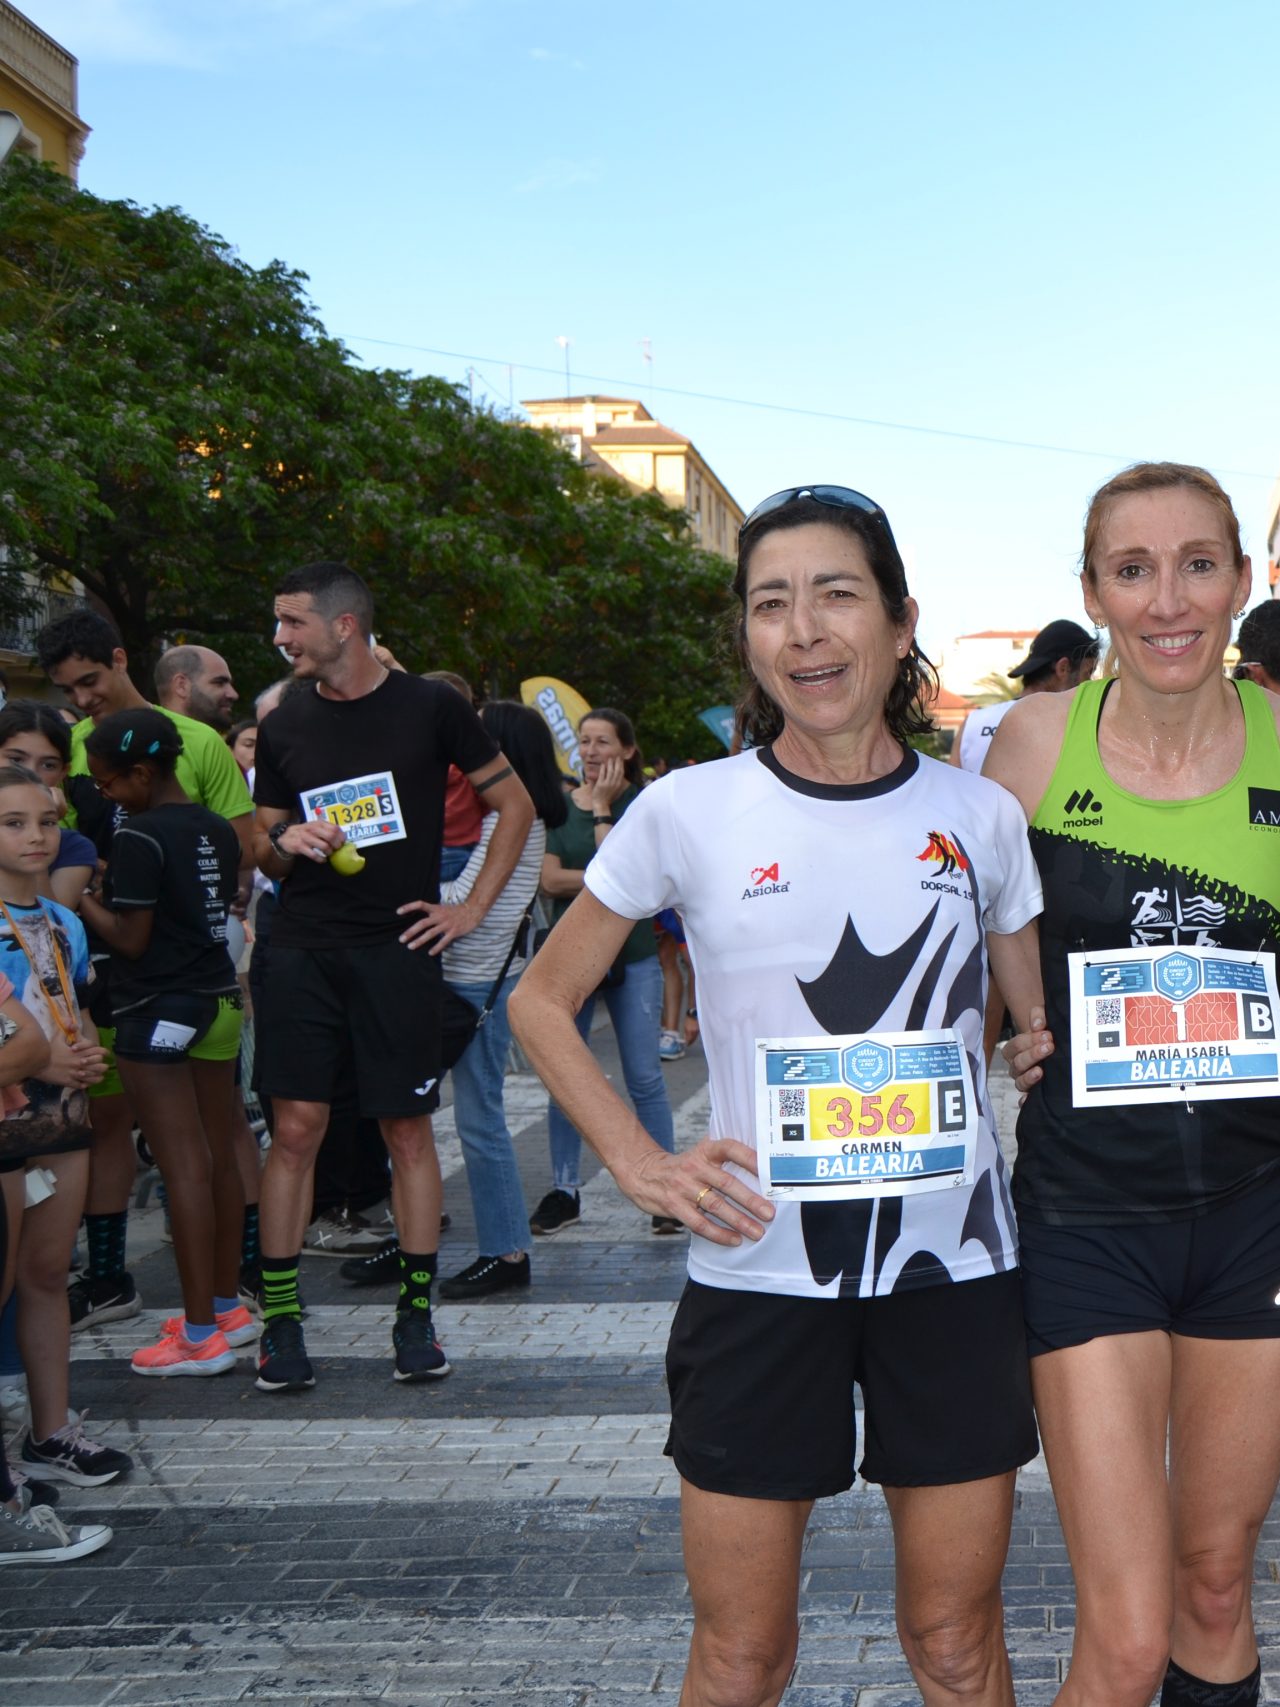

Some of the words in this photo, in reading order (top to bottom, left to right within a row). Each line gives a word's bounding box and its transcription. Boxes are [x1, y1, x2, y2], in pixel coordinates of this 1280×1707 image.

[330, 802, 376, 826] 1328
[381, 797, 393, 813] S
[1063, 816, 1103, 828] mobel
[741, 882, 789, 900] Asioka
[921, 880, 962, 897] DORSAL
[1171, 1003, 1187, 1041] 1
[1249, 1002, 1273, 1033] B
[1136, 1046, 1181, 1060] MARÍA
[1186, 1045, 1231, 1058] ISABEL
[945, 1090, 963, 1123] E
[826, 1094, 915, 1138] 356
[841, 1141, 902, 1155] CARMEN
